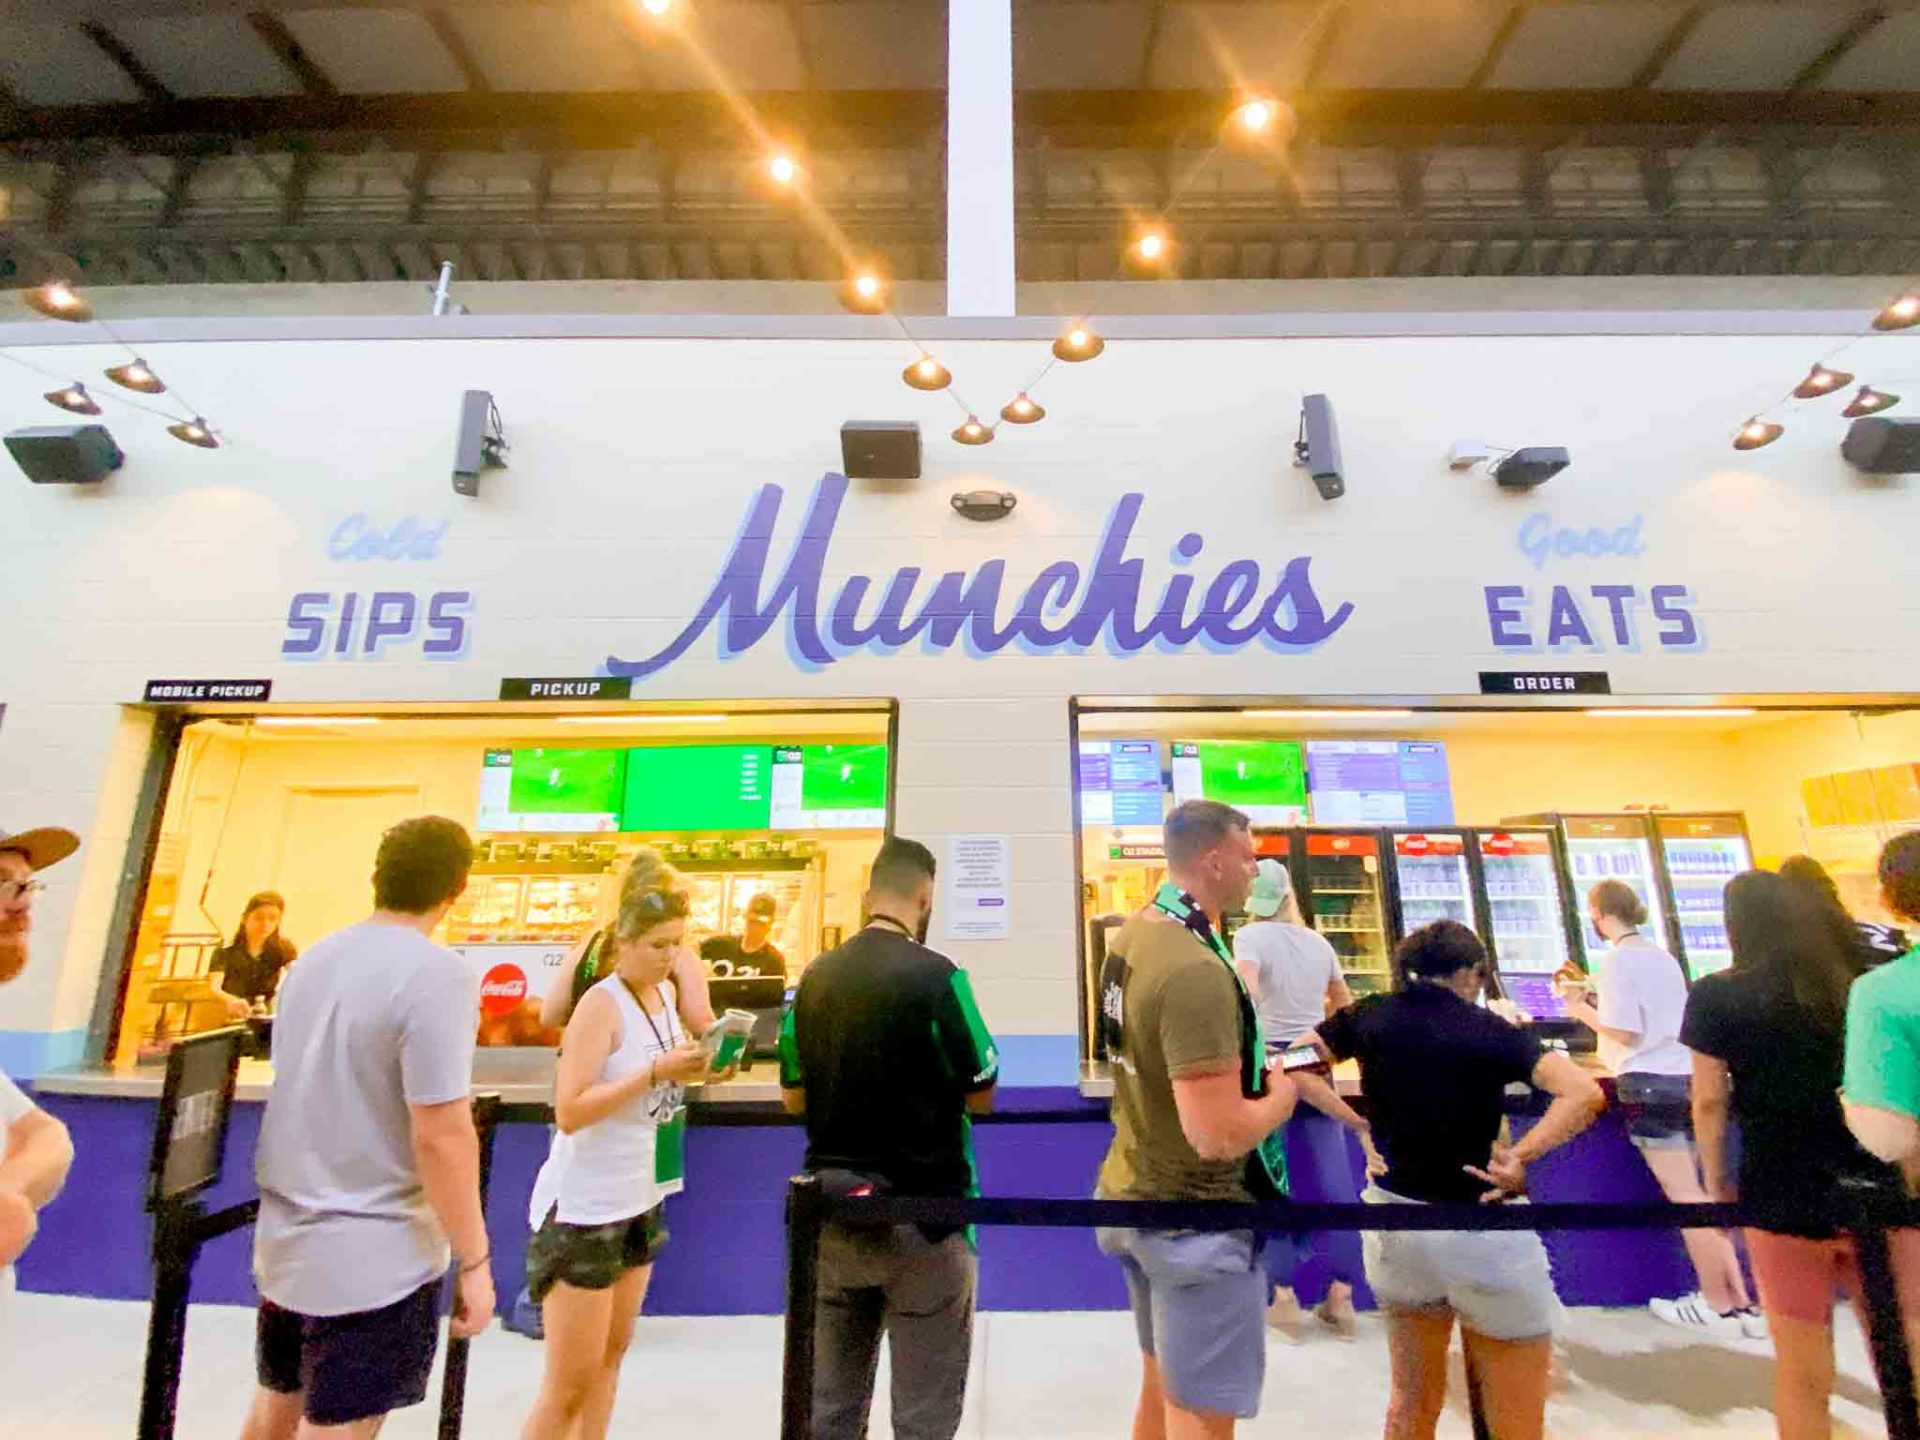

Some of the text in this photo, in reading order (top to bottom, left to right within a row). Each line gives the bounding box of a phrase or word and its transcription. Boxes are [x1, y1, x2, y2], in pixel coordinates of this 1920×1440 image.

[327, 513, 450, 562] Cold
[1517, 511, 1645, 569] Good
[605, 472, 1355, 678] Munchies
[281, 591, 473, 658] SIPS
[1484, 584, 1704, 651] EATS
[150, 685, 265, 697] MOBILE PICKUP
[530, 682, 600, 696] PICKUP
[1513, 677, 1575, 690] ORDER
